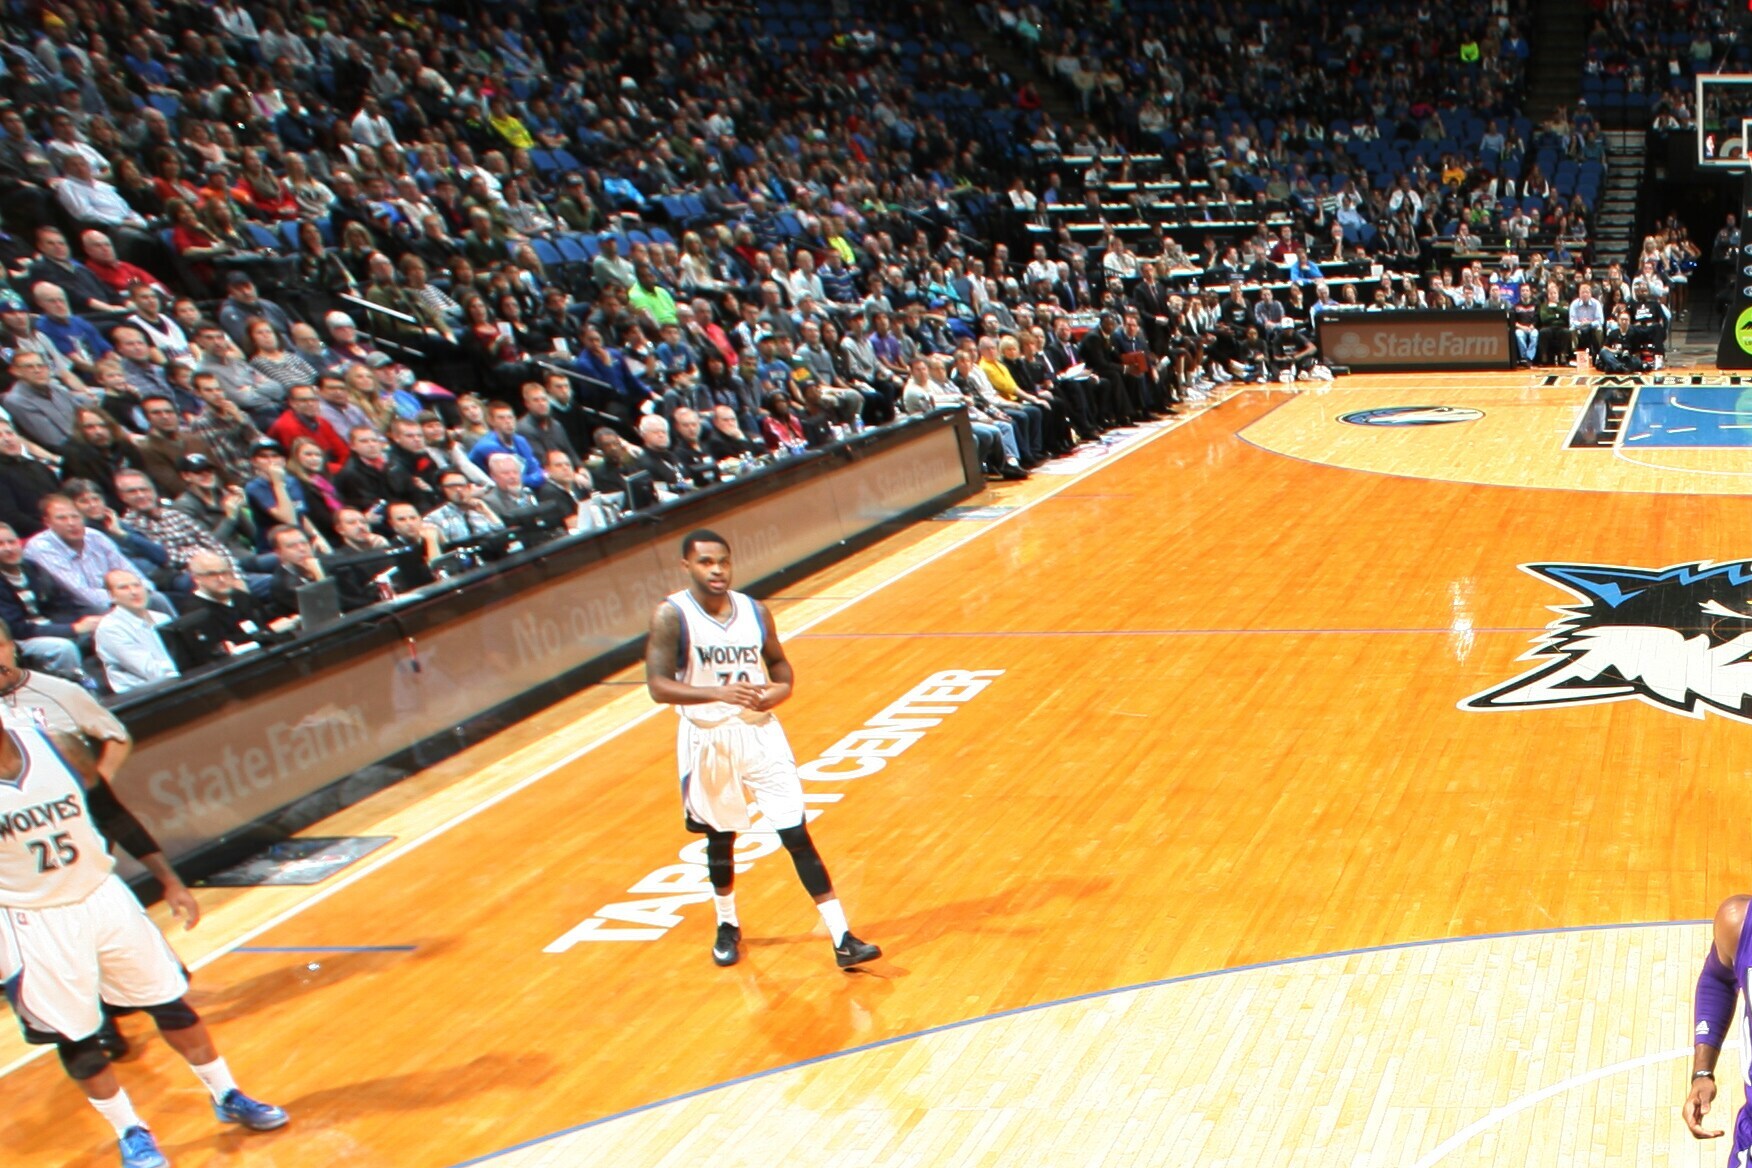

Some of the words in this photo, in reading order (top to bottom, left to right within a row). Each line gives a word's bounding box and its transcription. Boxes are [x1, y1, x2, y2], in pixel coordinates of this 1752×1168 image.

[695, 645, 758, 669] WOLVES
[798, 670, 1006, 781] CENTER
[0, 794, 81, 841] WOLVES
[26, 831, 80, 873] 25
